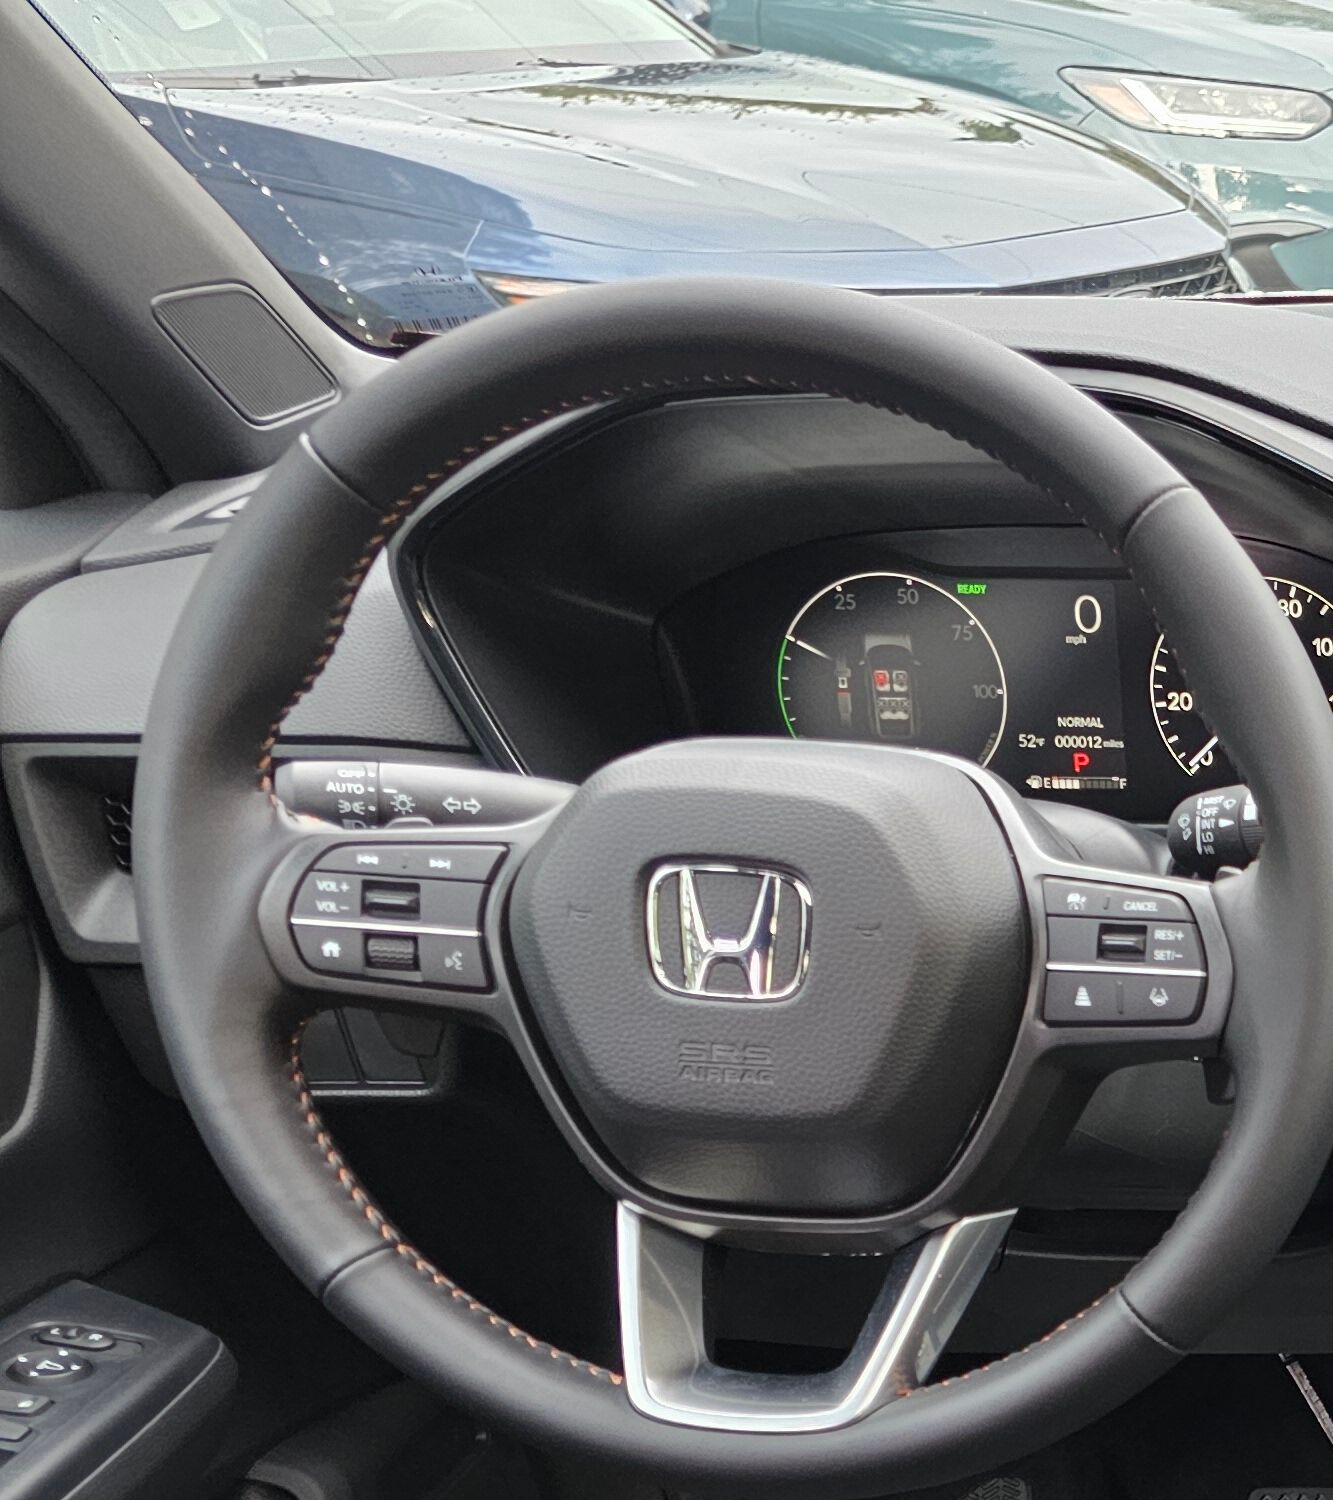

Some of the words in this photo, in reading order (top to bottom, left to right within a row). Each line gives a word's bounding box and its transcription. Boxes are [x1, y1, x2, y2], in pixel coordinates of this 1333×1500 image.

[956, 583, 987, 595] READY
[834, 593, 857, 610] 25
[897, 588, 919, 605] 50
[1074, 594, 1101, 634] 0
[951, 625, 973, 641] 75
[1066, 634, 1087, 645] mph
[973, 684, 998, 699] 100
[1167, 692, 1193, 711] 20
[1057, 716, 1104, 728] NORMAL
[1054, 736, 1102, 748] 000012
[1073, 752, 1090, 773] P
[326, 782, 365, 795] AUTO
[1120, 779, 1127, 789] F
[1201, 807, 1219, 818] OFF
[1201, 819, 1215, 829] INT
[1201, 832, 1214, 843] LO
[1123, 901, 1158, 913] CANCEL
